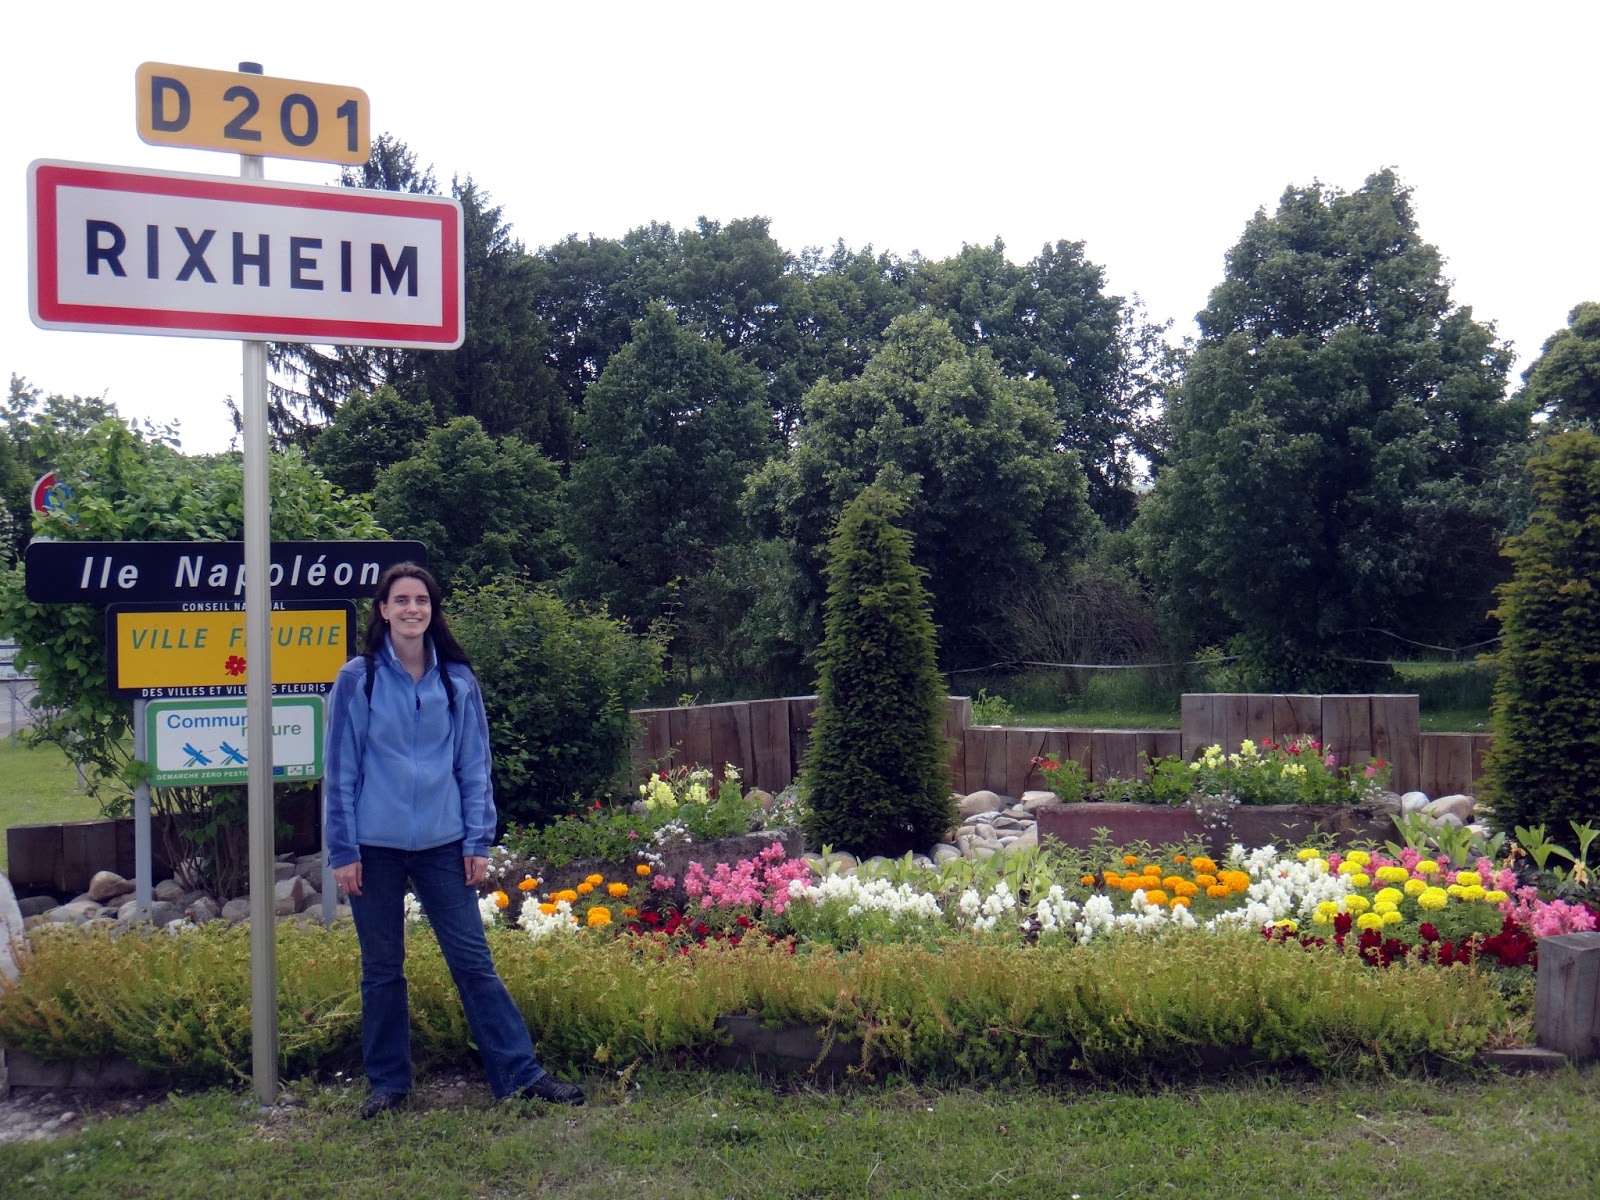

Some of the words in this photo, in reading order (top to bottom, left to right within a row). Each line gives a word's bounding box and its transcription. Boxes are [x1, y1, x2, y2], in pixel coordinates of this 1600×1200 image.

[151, 75, 191, 133] D
[223, 85, 359, 153] 201
[85, 219, 418, 297] RIXHEIM
[80, 555, 139, 589] Ile
[182, 602, 230, 611] CONSEIL
[234, 601, 286, 611] NAAL
[131, 627, 208, 649] VILLE
[229, 625, 341, 648] FURIE
[142, 688, 163, 697] DES
[167, 687, 205, 697] VILLES
[209, 686, 221, 696] ET
[226, 684, 277, 696] VILLS
[281, 683, 326, 693] FLEURIS
[201, 770, 222, 779] ZÉRO
